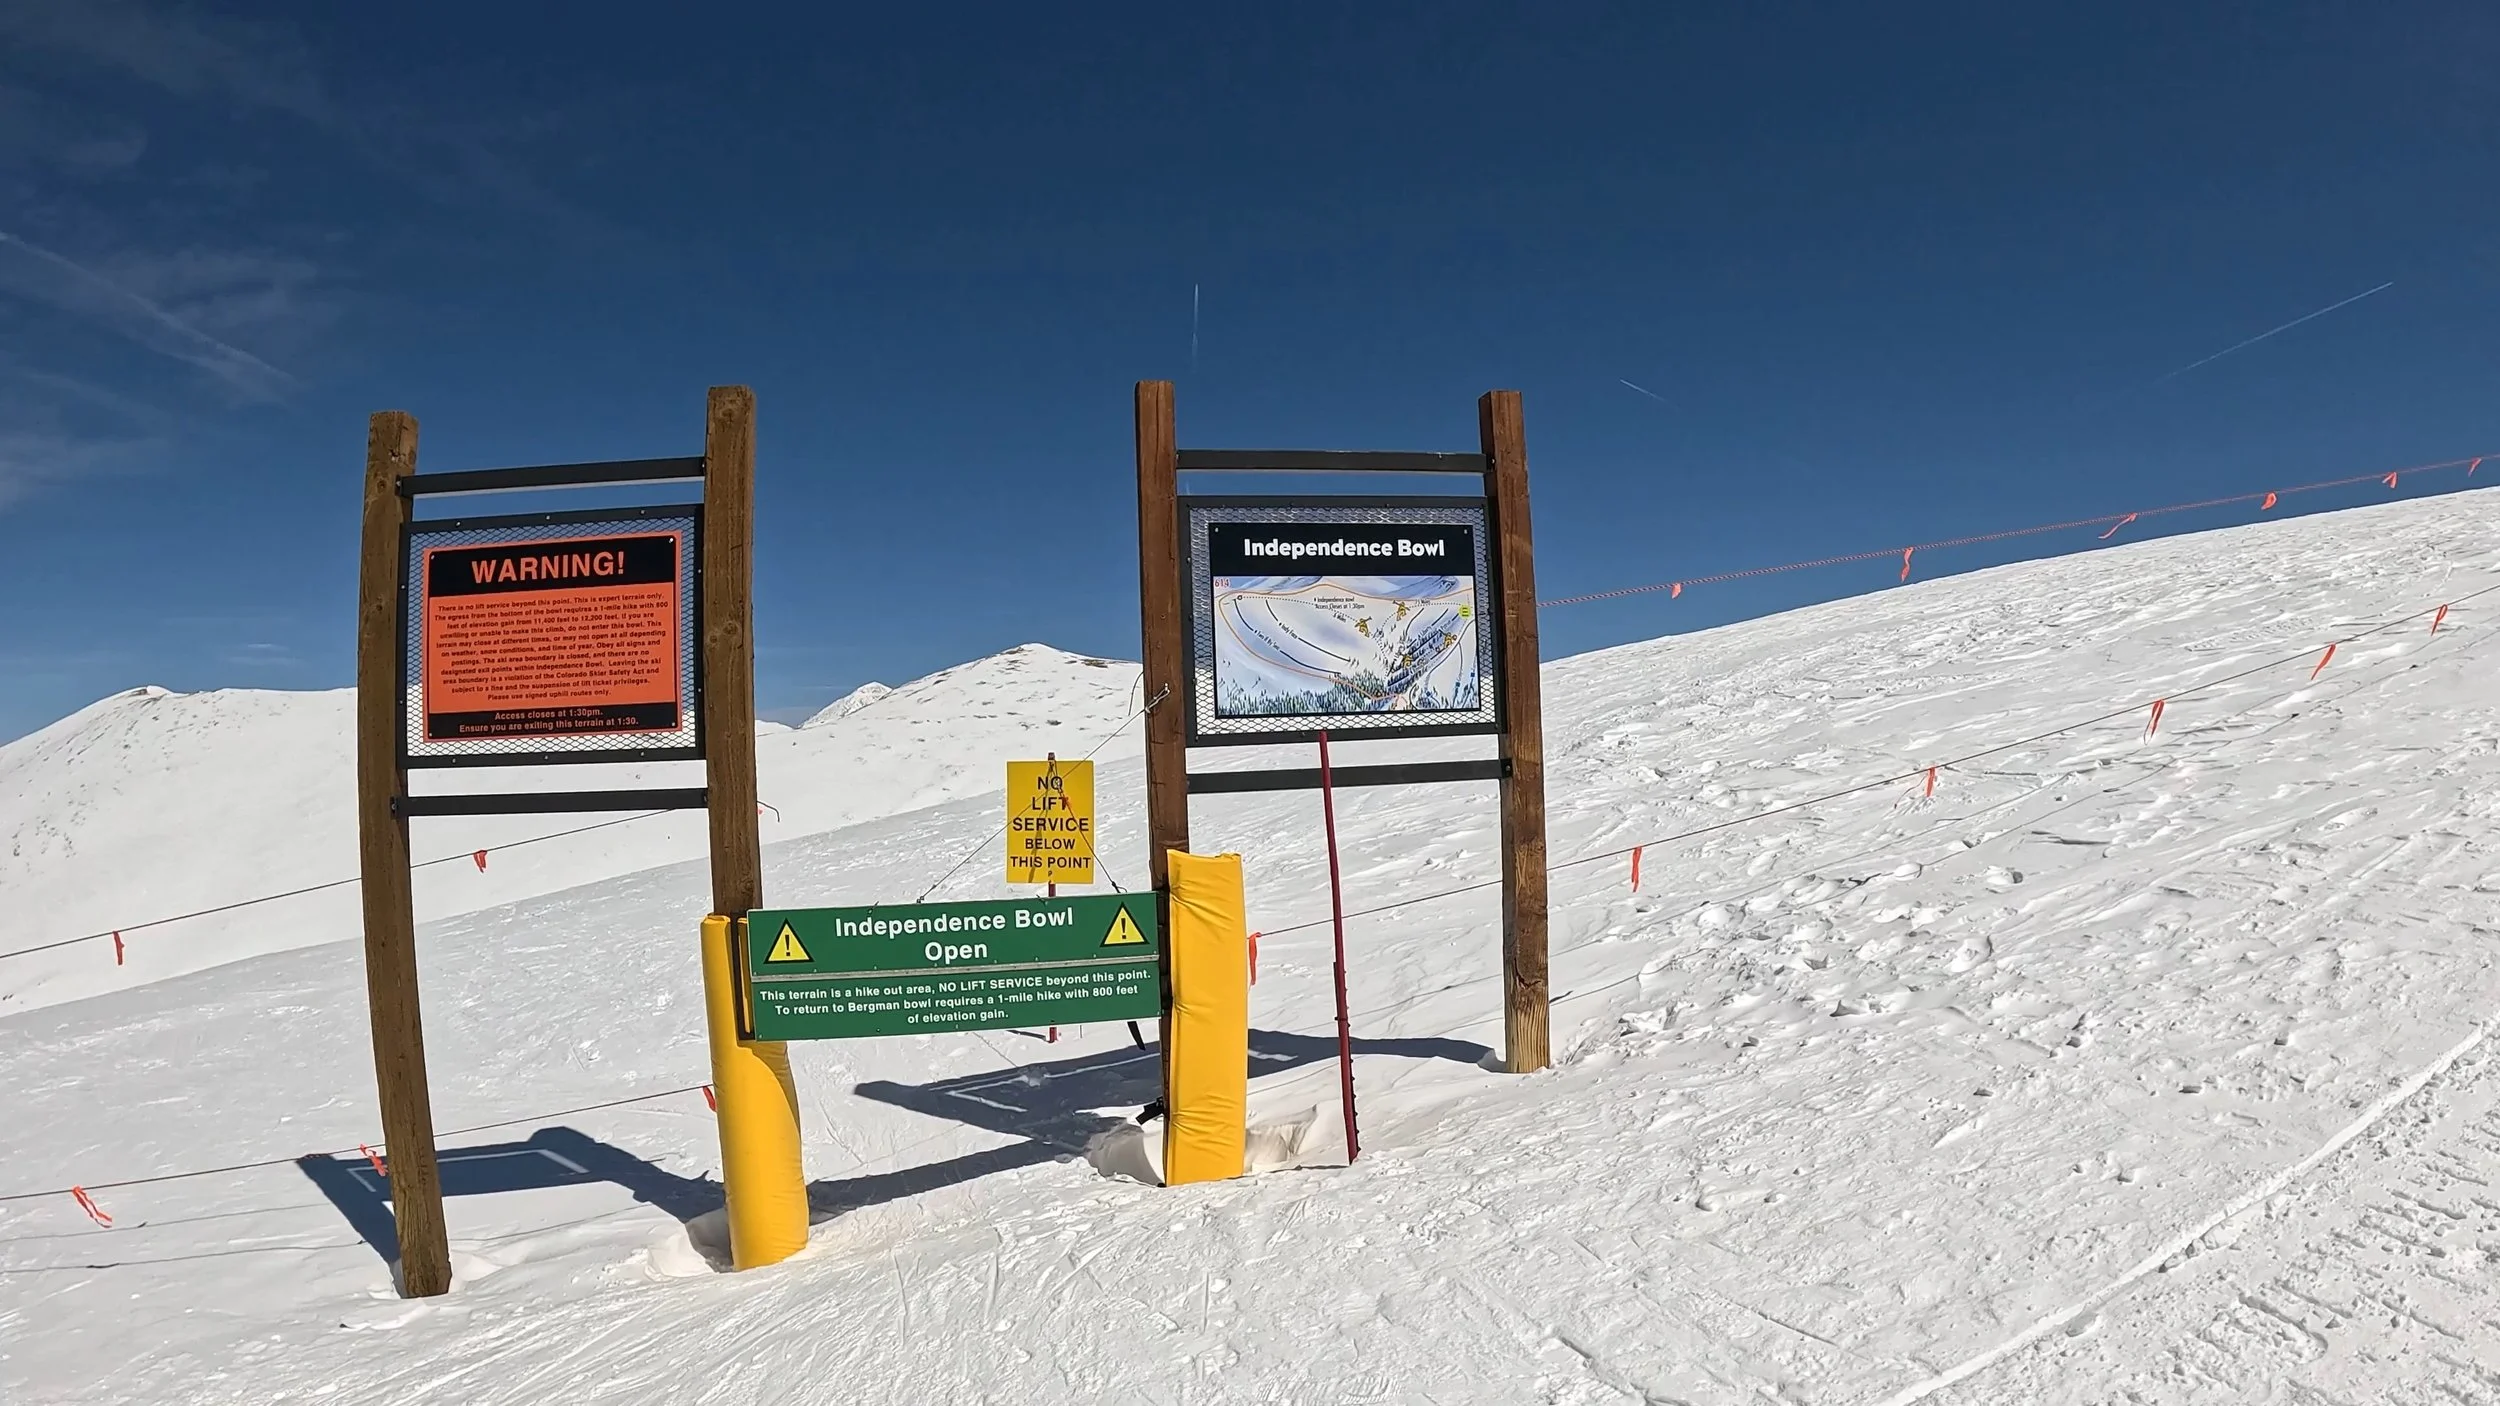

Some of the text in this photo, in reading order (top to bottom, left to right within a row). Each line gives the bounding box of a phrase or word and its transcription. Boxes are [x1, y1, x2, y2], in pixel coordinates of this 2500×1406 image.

[1244, 538, 1444, 559] Independence Bowl
[472, 552, 624, 584] WARNING!
[511, 599, 536, 608] beyond
[500, 619, 514, 627] gain
[629, 629, 666, 638] depending
[491, 665, 512, 673] points
[535, 662, 583, 670] Independence
[524, 691, 547, 699] signed
[527, 710, 555, 718] closes
[569, 708, 602, 717] 1:30pm.
[459, 724, 488, 732] Ensure
[490, 724, 506, 732] you
[524, 720, 553, 730] exiting
[555, 719, 572, 728] this
[574, 718, 603, 727] terrain
[617, 716, 638, 725] 1:30.
[1038, 776, 1063, 790] NO
[1032, 797, 1068, 810] LIFT
[1013, 818, 1089, 831] SERVICE
[1025, 839, 1075, 849] BELOW
[1010, 856, 1091, 868] THIS POINT
[835, 906, 1072, 938] Independence Bowl
[924, 941, 987, 964] Open
[760, 990, 785, 1000] This
[788, 988, 826, 999] terrain
[830, 988, 840, 997] is
[855, 986, 879, 996] hike
[883, 985, 902, 995] out
[906, 985, 934, 994] area,
[938, 982, 956, 992] NO
[960, 980, 985, 990] LIFT
[989, 976, 1042, 989] SERVICE
[1046, 973, 1088, 986] beyond
[1092, 972, 1114, 982] this
[1118, 969, 1150, 982] point.
[774, 1005, 789, 1014] To
[793, 1004, 828, 1014] return
[832, 1003, 844, 1012] to
[848, 1002, 899, 1013] Bergman
[903, 998, 931, 1008] bowl
[935, 996, 983, 1008] requires
[998, 992, 1033, 1003] 1-mile
[1036, 990, 1060, 1000] hike
[1064, 988, 1088, 998] with
[1092, 986, 1112, 996] 800
[1116, 984, 1137, 994] feet
[907, 1008, 1008, 1023] of elevation gain.
